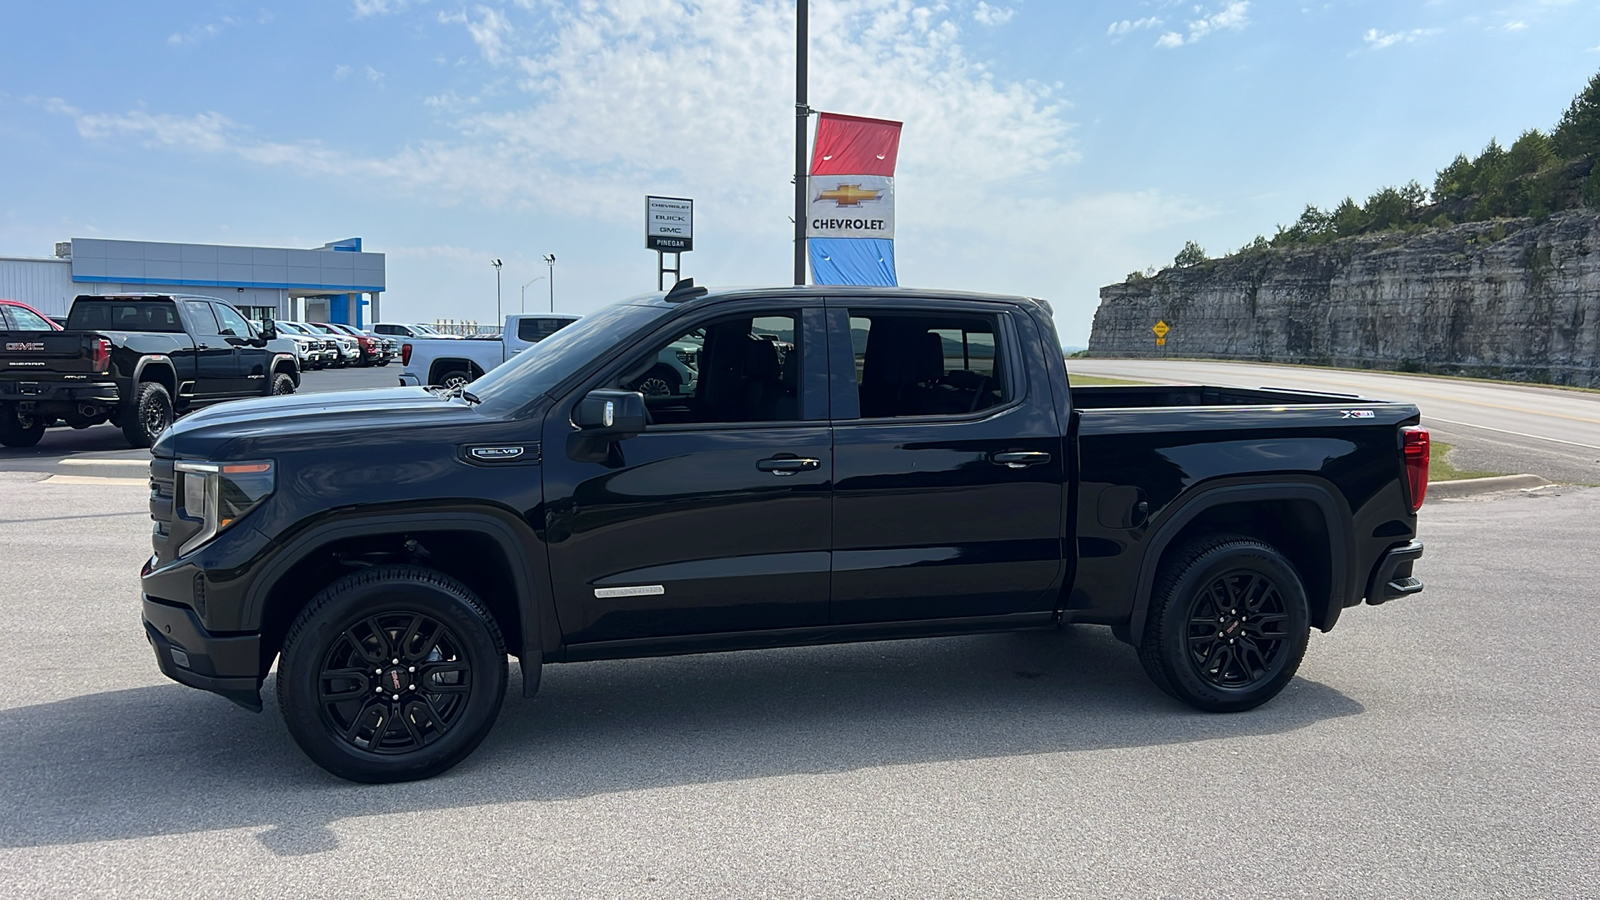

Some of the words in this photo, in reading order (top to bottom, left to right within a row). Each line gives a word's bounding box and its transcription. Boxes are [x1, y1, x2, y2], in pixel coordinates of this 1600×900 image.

[651, 202, 690, 210] CHEVROLET
[655, 214, 686, 222] BUICK
[812, 218, 885, 231] CHEVROLET
[659, 226, 682, 234] GMC
[656, 239, 685, 248] PINEGAR
[5, 342, 45, 351] GMC
